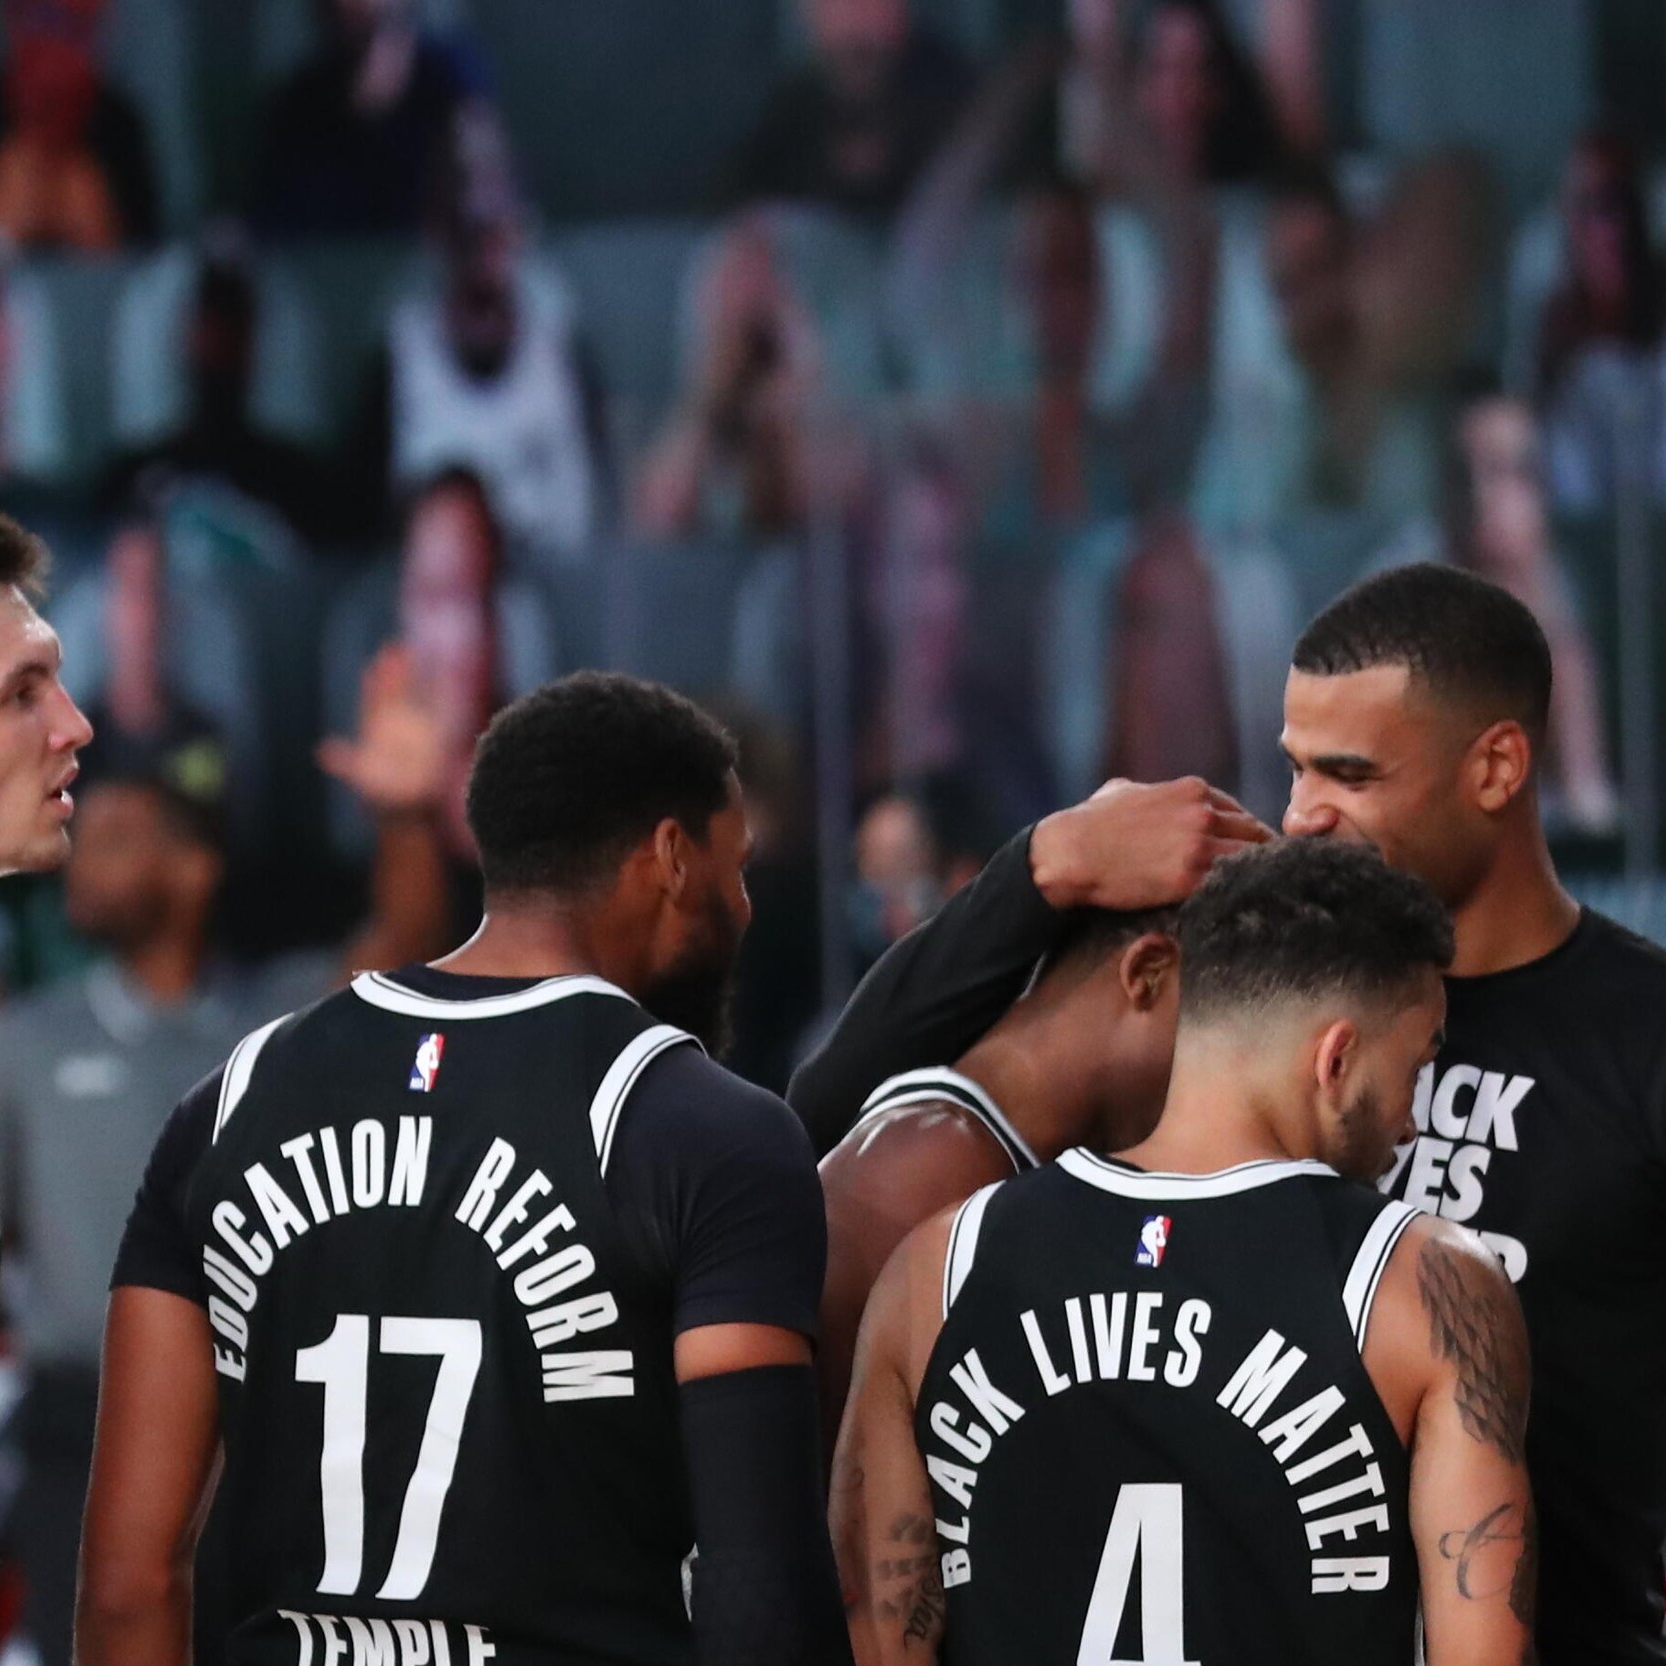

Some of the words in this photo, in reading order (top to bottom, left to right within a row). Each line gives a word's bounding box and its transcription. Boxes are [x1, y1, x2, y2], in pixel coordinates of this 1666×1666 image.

[203, 1115, 433, 1384] EDUCATION
[454, 1136, 635, 1403] REFORM
[294, 1312, 483, 1601] 17
[926, 1346, 1026, 1590] BLACK
[1019, 1291, 1212, 1397] LIVES
[1215, 1327, 1391, 1595] MATTER
